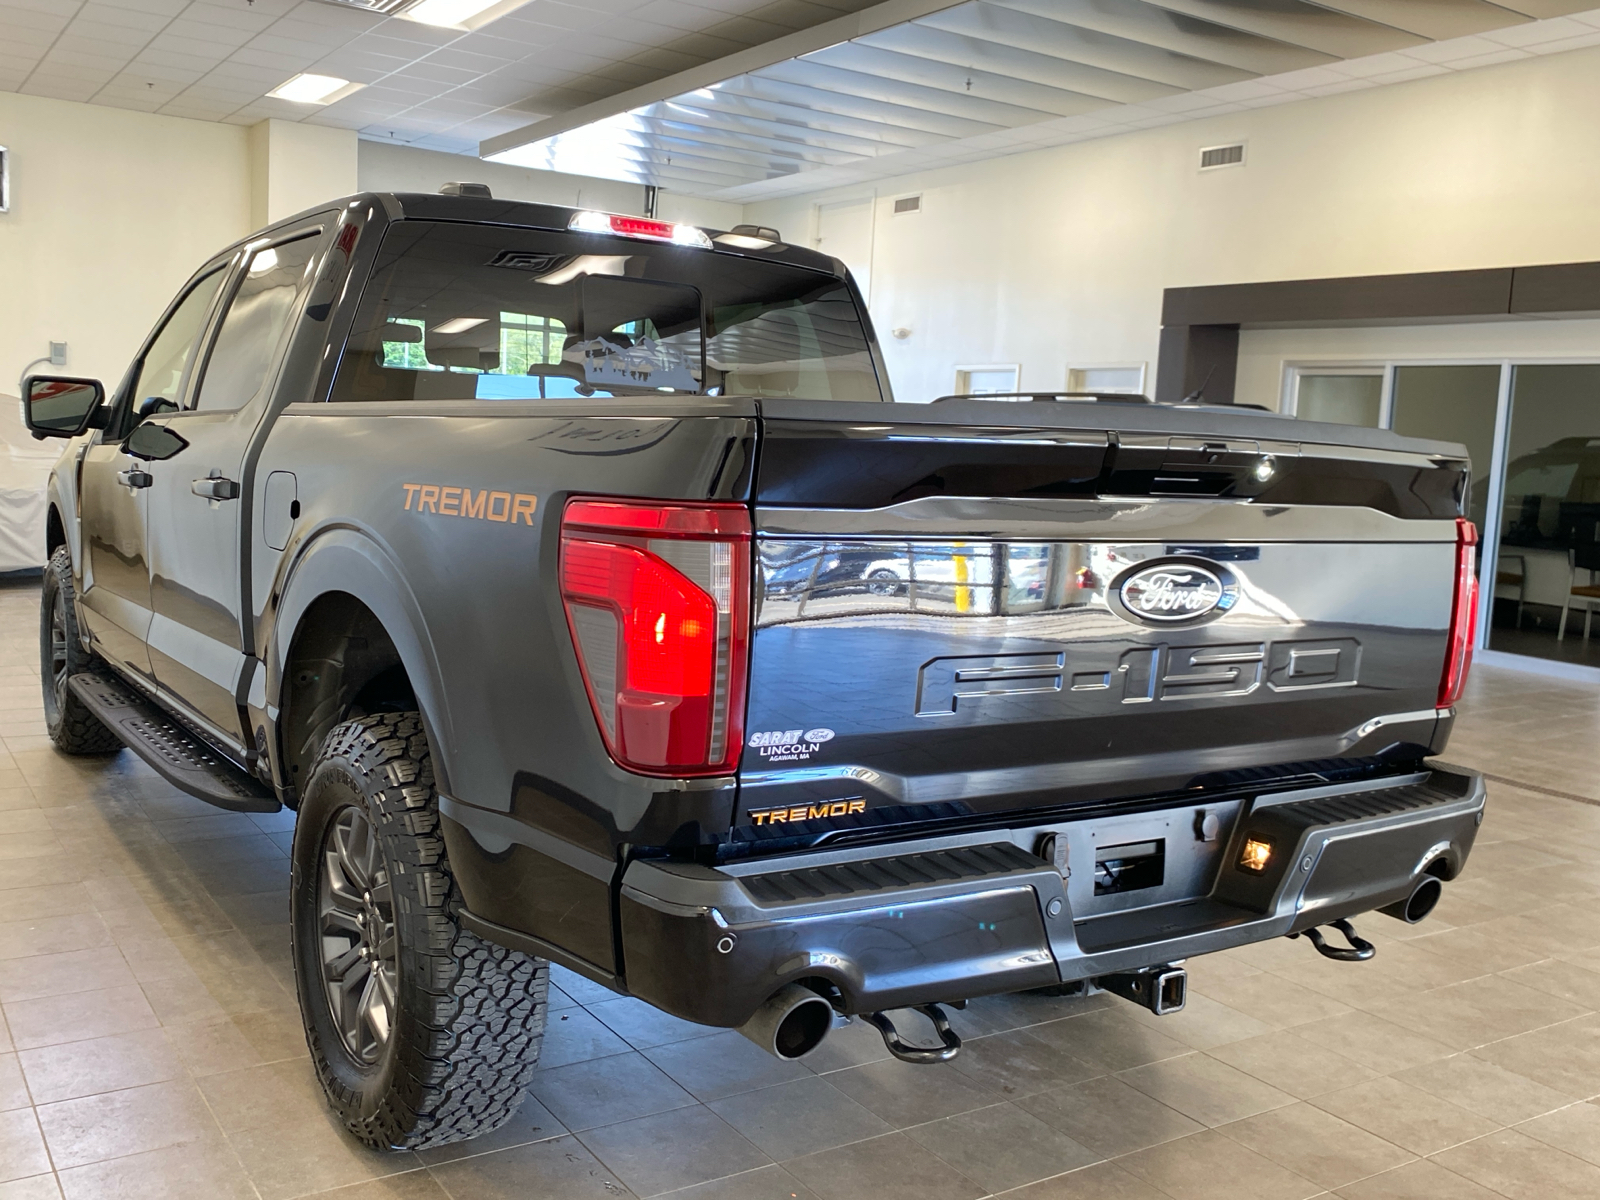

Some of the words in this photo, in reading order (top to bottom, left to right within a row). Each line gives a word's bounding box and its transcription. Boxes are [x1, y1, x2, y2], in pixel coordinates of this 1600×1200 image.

[402, 483, 538, 526] TREMOR
[1141, 573, 1207, 610] Ford
[914, 637, 1362, 717] F-150
[749, 730, 803, 747] SARAT
[760, 743, 820, 756] LINCOLN
[751, 798, 866, 826] TREMOR
